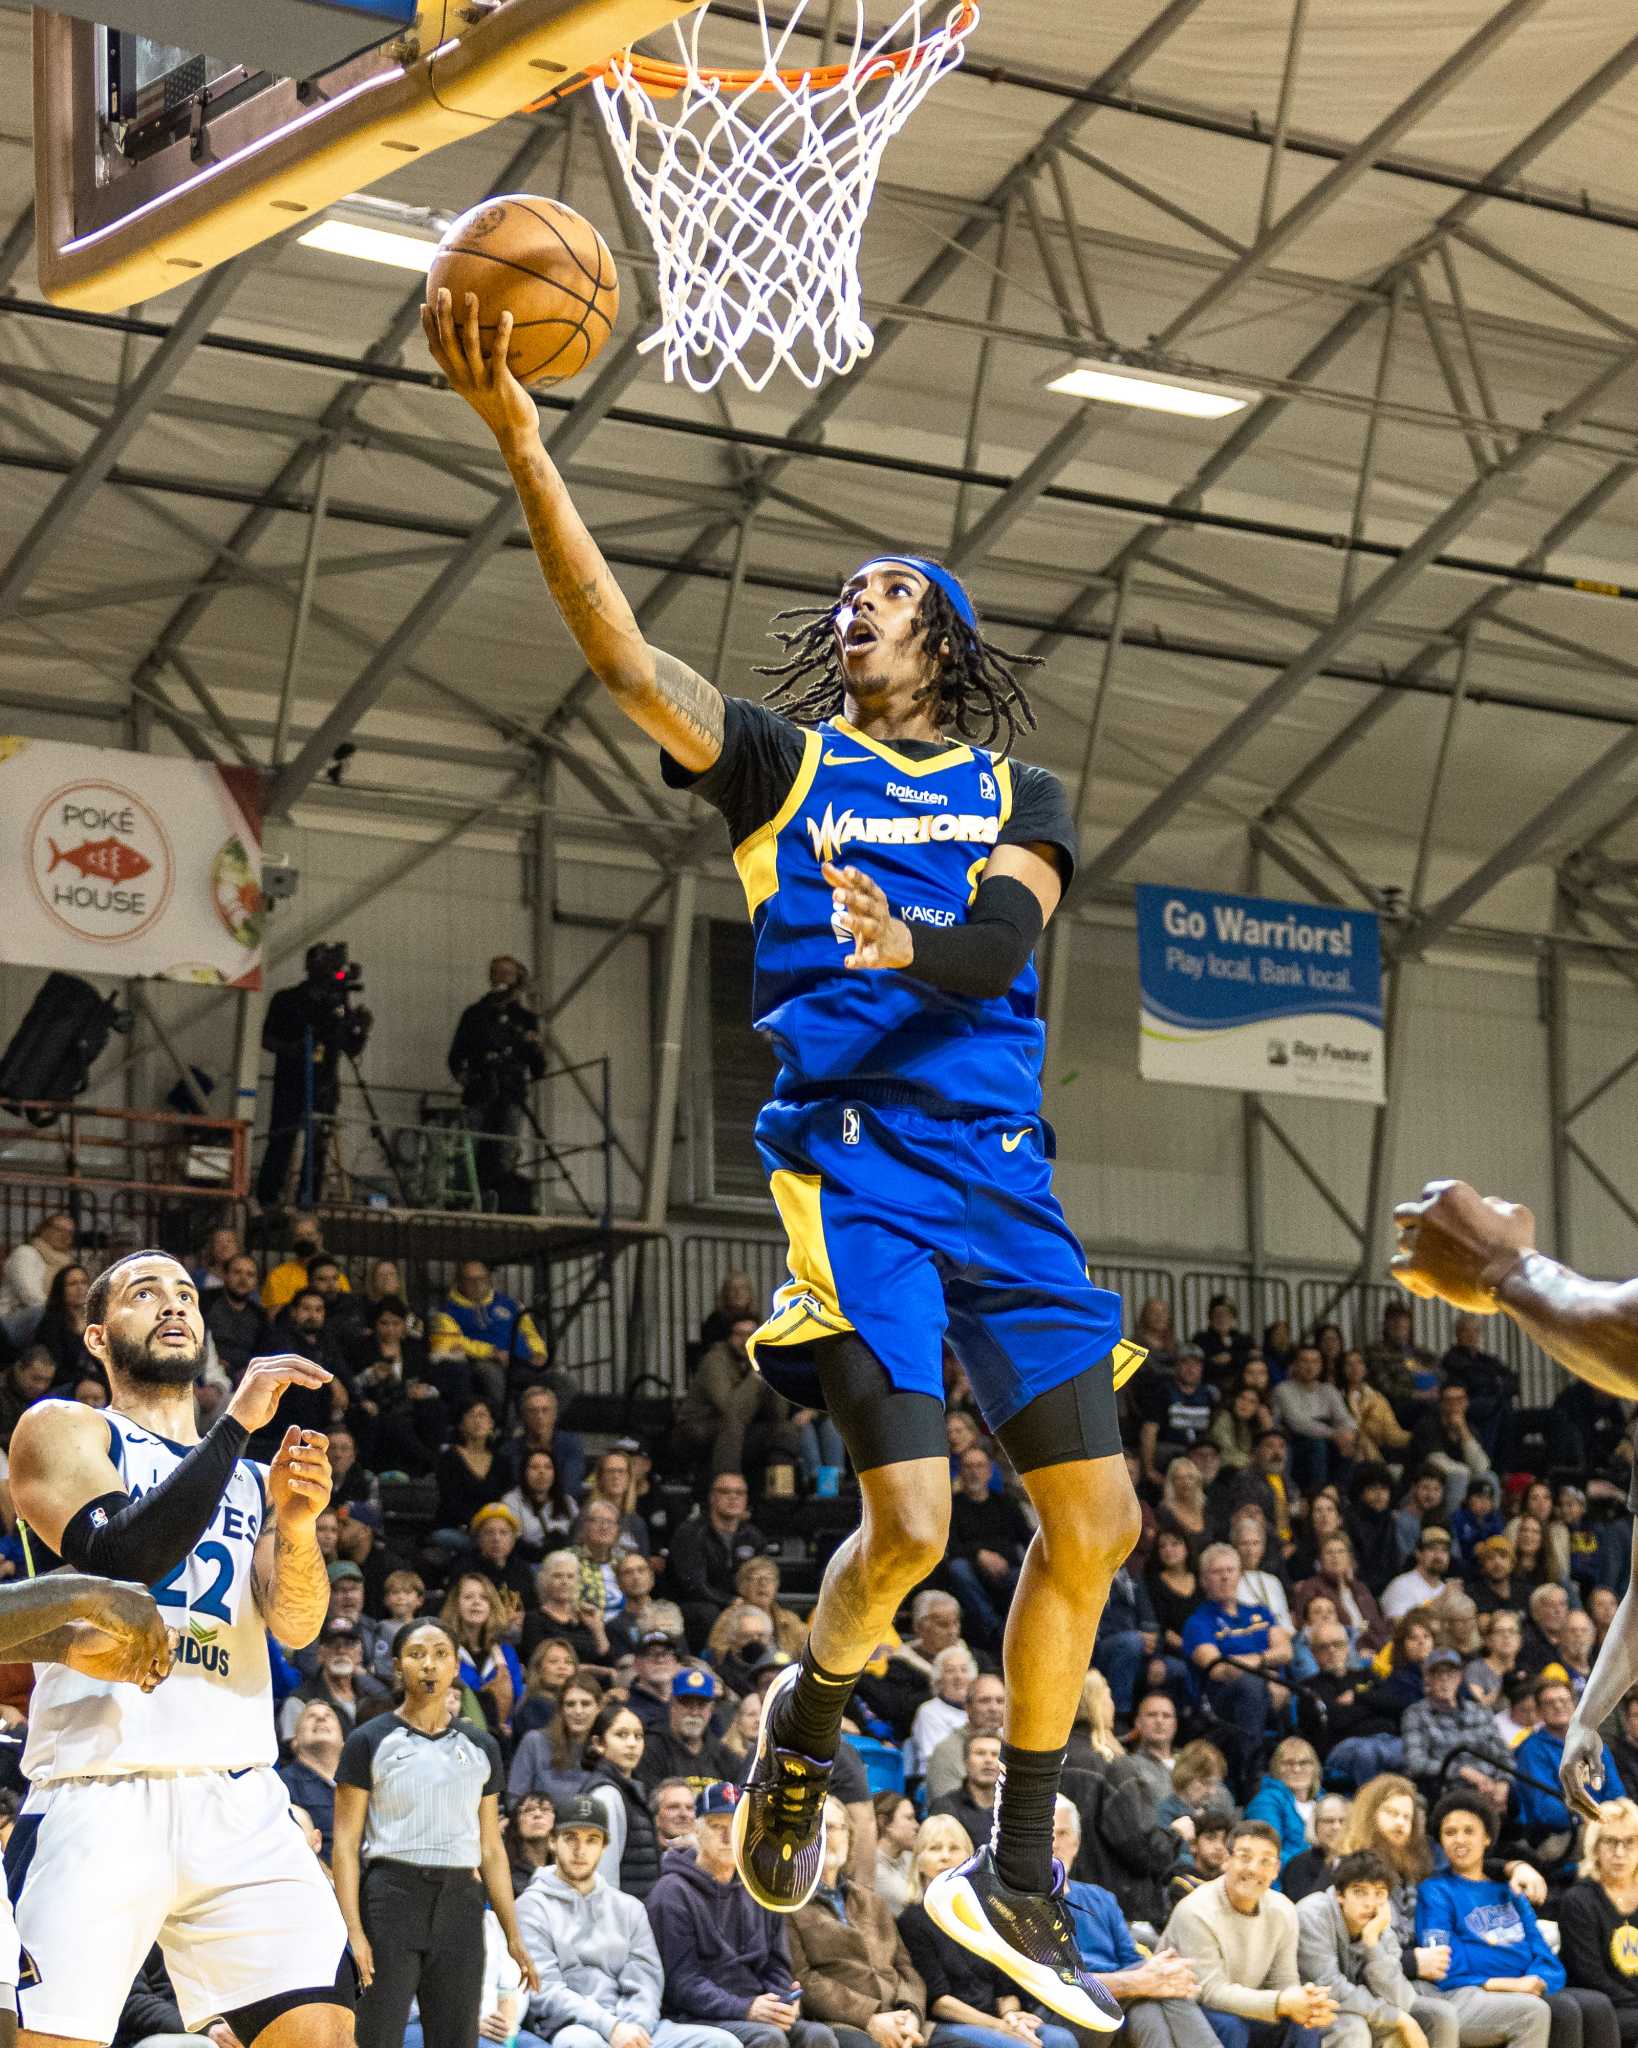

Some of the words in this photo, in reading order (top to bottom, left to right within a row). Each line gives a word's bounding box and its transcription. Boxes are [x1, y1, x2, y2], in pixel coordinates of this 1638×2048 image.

[885, 782, 949, 807] Rakuten
[54, 884, 145, 915] HOUSE
[901, 905, 956, 928] KAISER
[1163, 900, 1207, 939] Go
[1213, 905, 1352, 957] Warriors!
[1165, 947, 1205, 980] Pay
[1258, 957, 1304, 986] Bank
